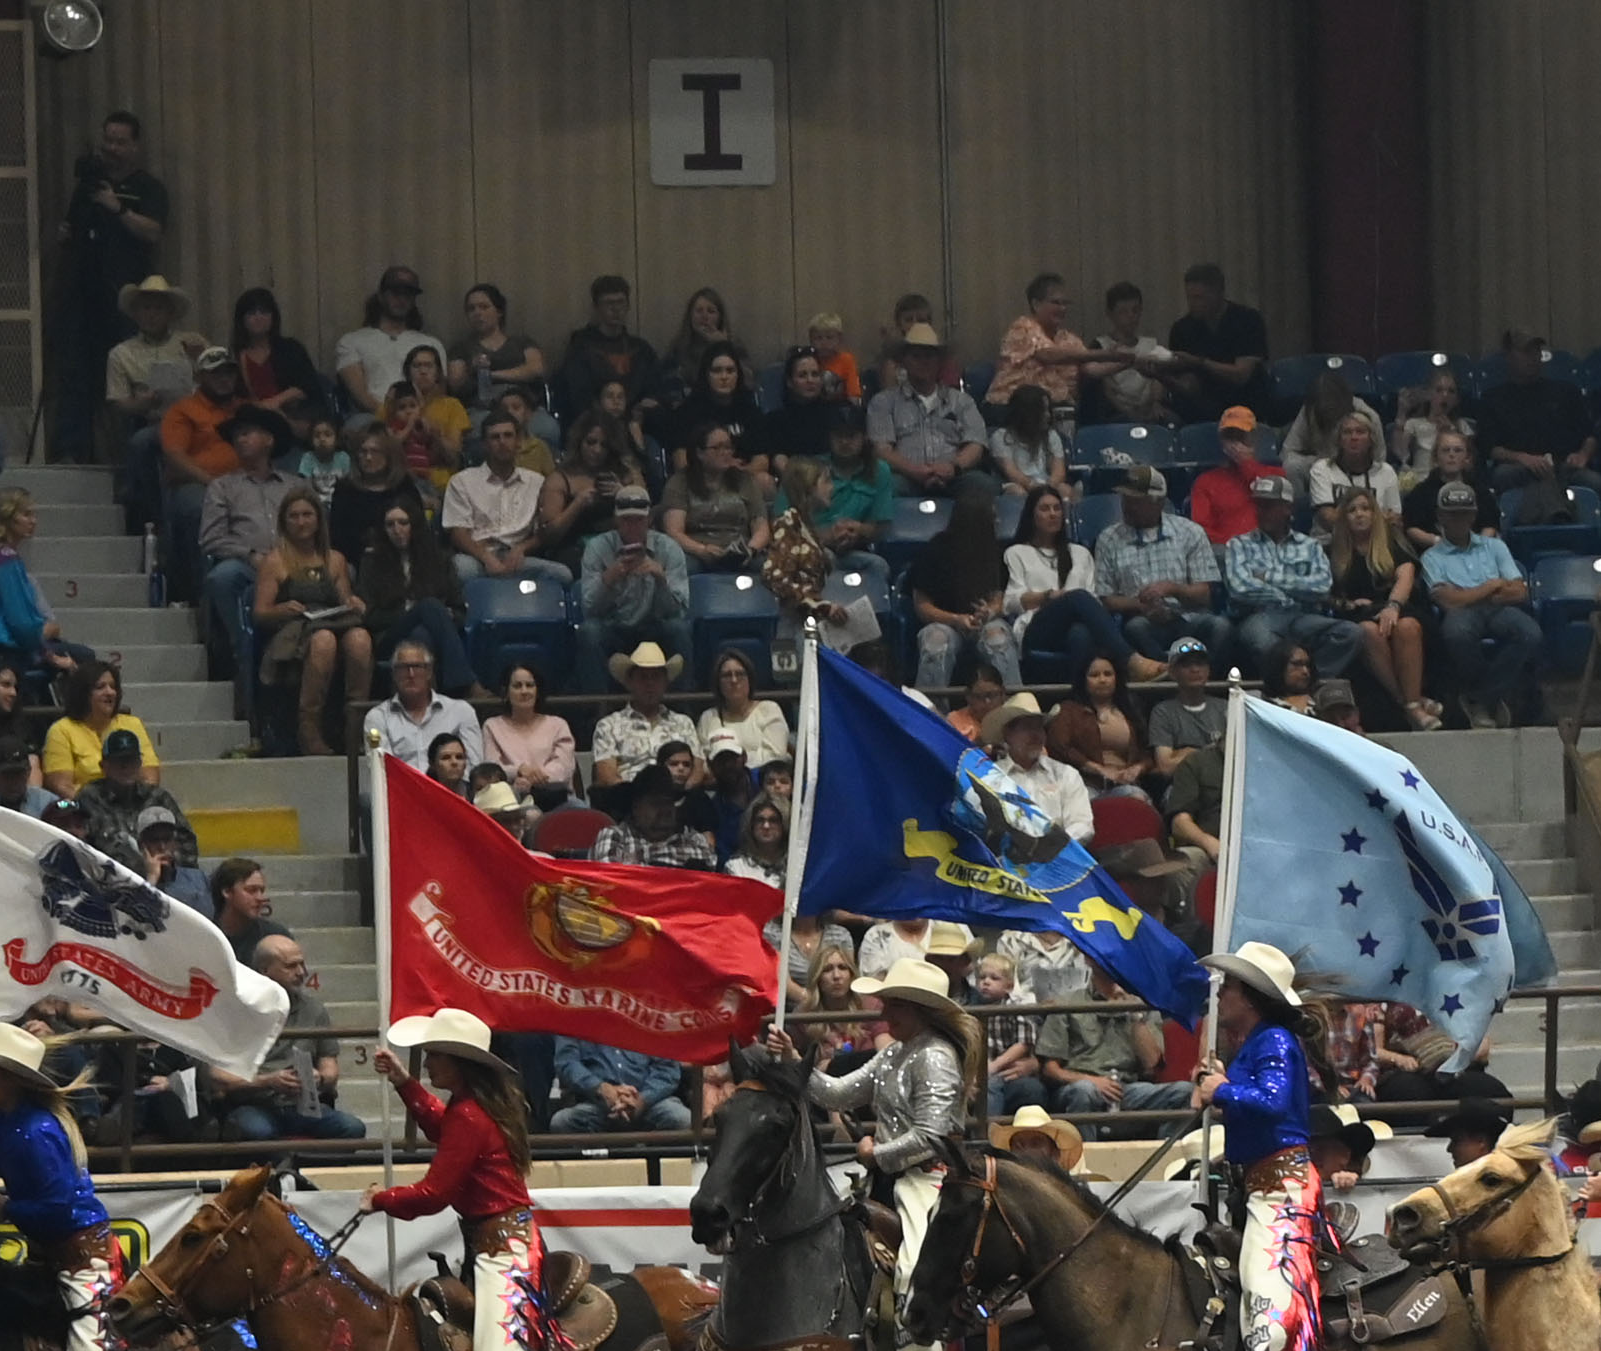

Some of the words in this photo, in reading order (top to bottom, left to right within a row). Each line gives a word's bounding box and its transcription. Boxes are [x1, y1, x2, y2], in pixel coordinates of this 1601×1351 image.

[682, 74, 742, 170] I
[65, 580, 78, 598] 3
[946, 861, 991, 884] UNITED
[305, 972, 321, 991] 4
[432, 928, 498, 988] UNITED
[499, 972, 572, 1006] STATES
[581, 989, 668, 1031] MARINE
[124, 980, 185, 1017] ARMY
[355, 1046, 368, 1065] 3
[1405, 1290, 1441, 1324] Ellen
